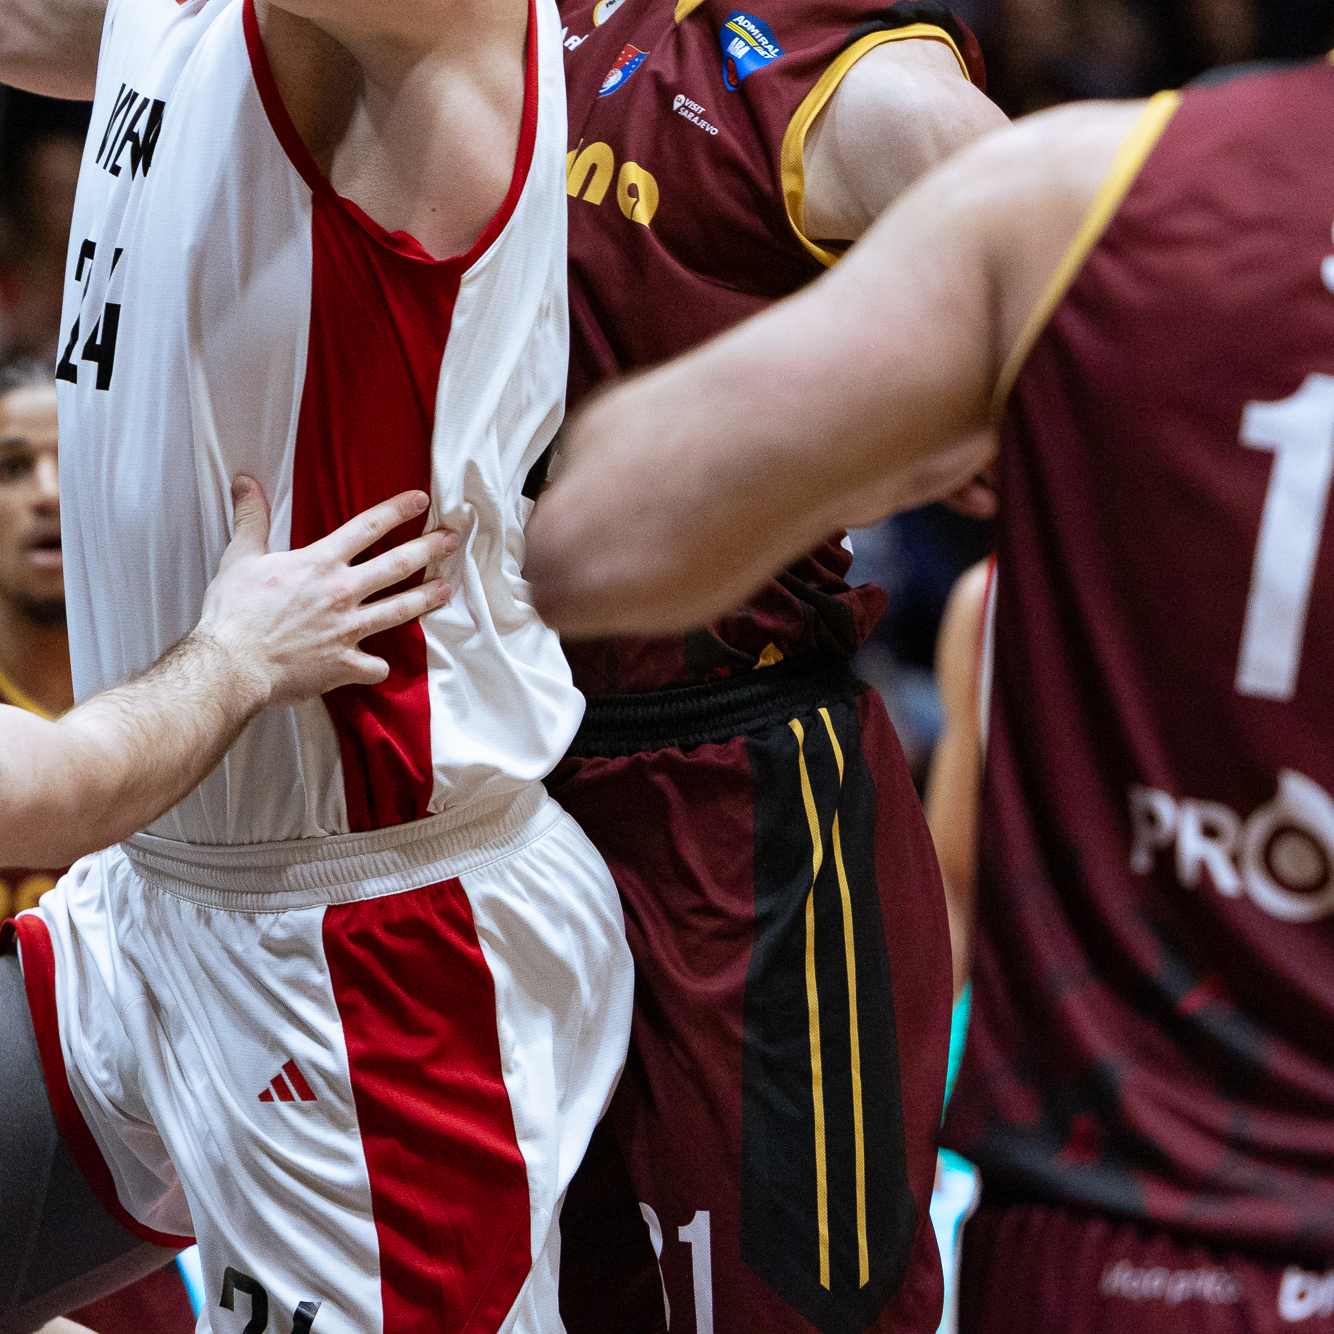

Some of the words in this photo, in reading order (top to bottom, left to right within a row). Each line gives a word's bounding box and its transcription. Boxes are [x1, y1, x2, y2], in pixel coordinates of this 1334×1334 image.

[732, 15, 780, 58] ADMIRAL
[677, 107, 720, 136] SARAJEVO
[684, 97, 706, 115] VISIT
[55, 237, 124, 392] 24
